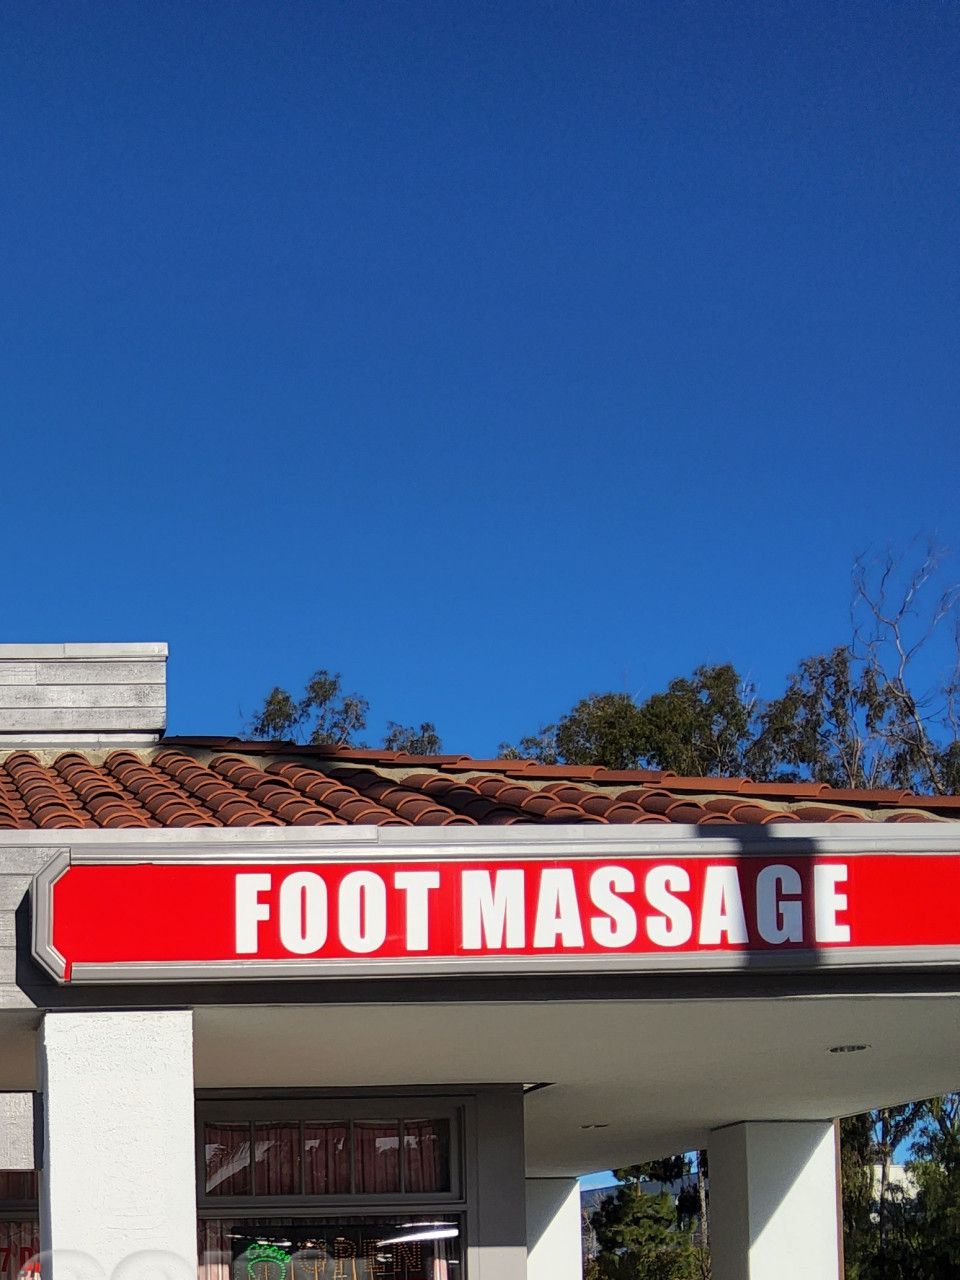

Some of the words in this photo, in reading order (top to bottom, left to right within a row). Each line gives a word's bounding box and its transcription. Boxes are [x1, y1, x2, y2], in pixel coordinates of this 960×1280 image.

[235, 870, 440, 954] FOOT
[460, 863, 851, 950] MASSAGE
[0, 1247, 11, 1273] 7
[299, 1238, 421, 1273] OPEN
